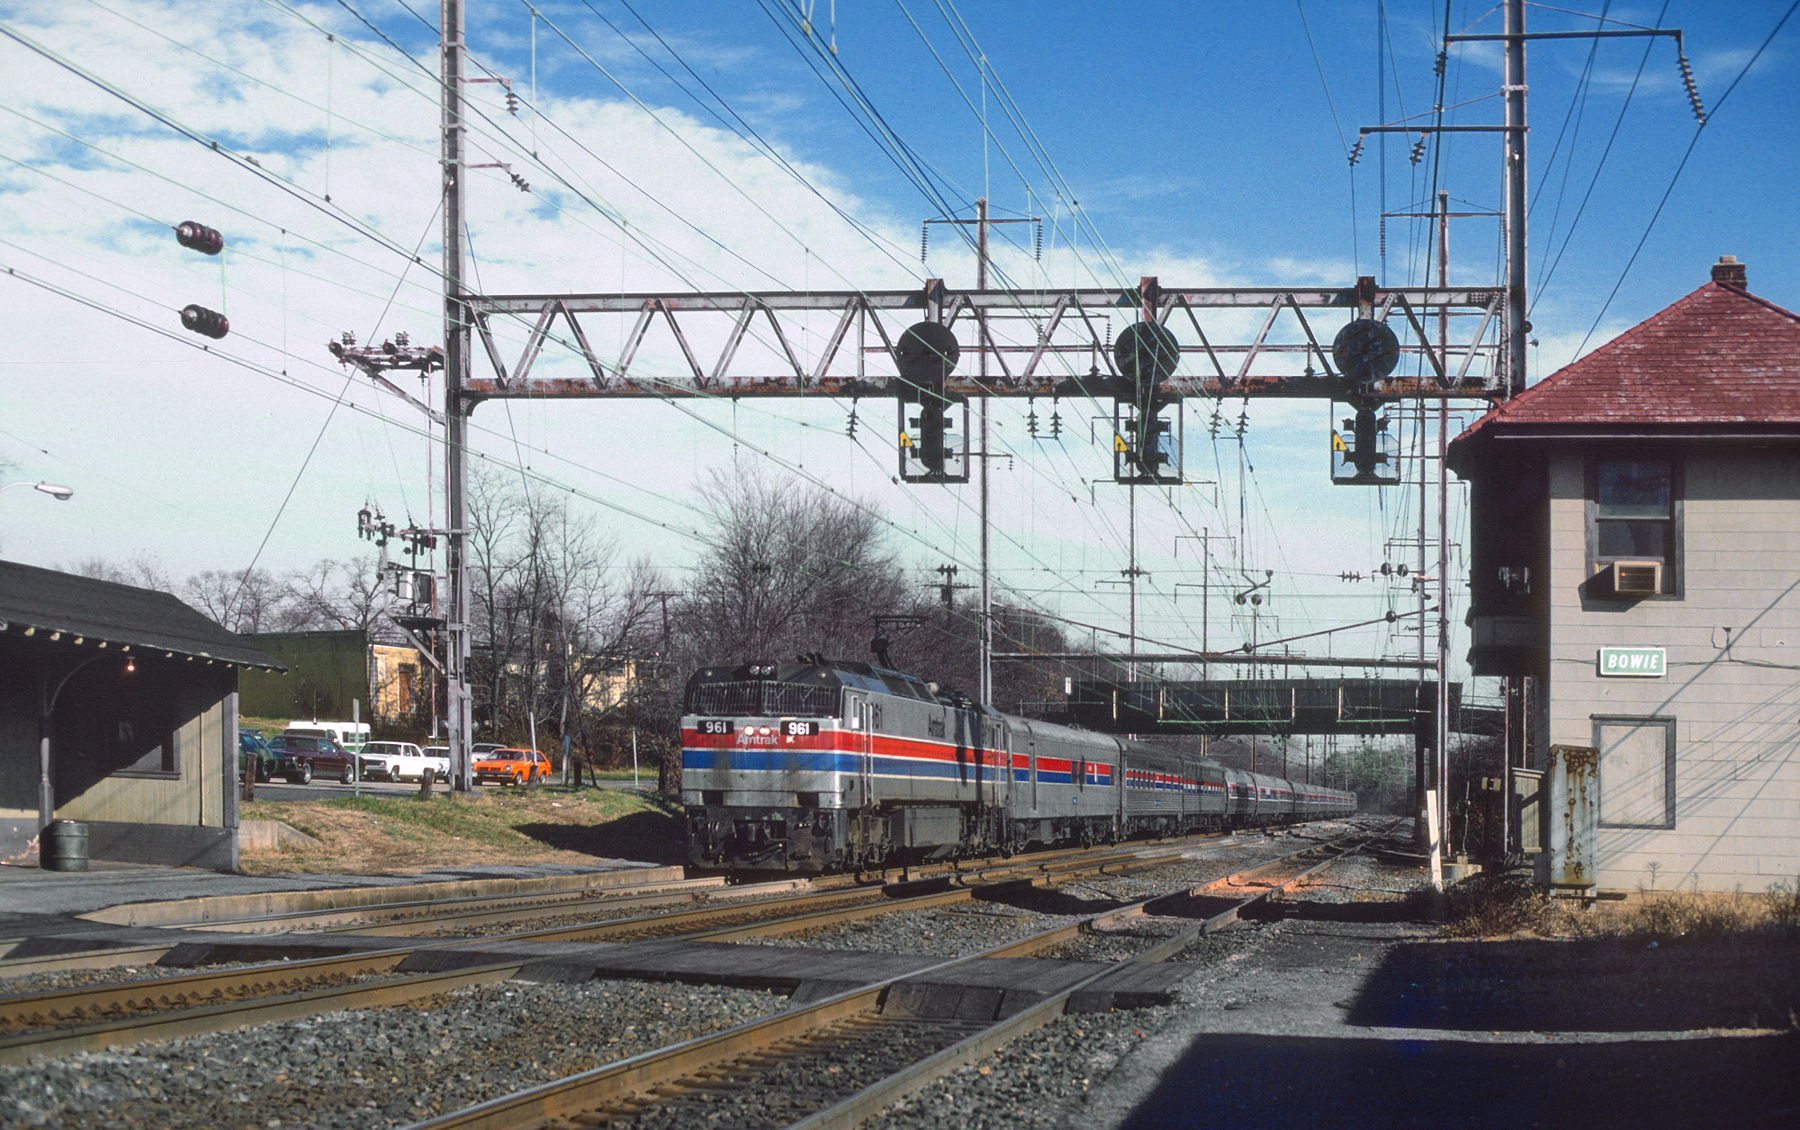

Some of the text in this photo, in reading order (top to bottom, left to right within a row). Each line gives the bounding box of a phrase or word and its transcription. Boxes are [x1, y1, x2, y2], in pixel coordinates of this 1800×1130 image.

[1608, 654, 1659, 669] BOWIE
[706, 721, 727, 734] 961
[788, 722, 810, 735] 961
[736, 734, 778, 745] Amtrak
